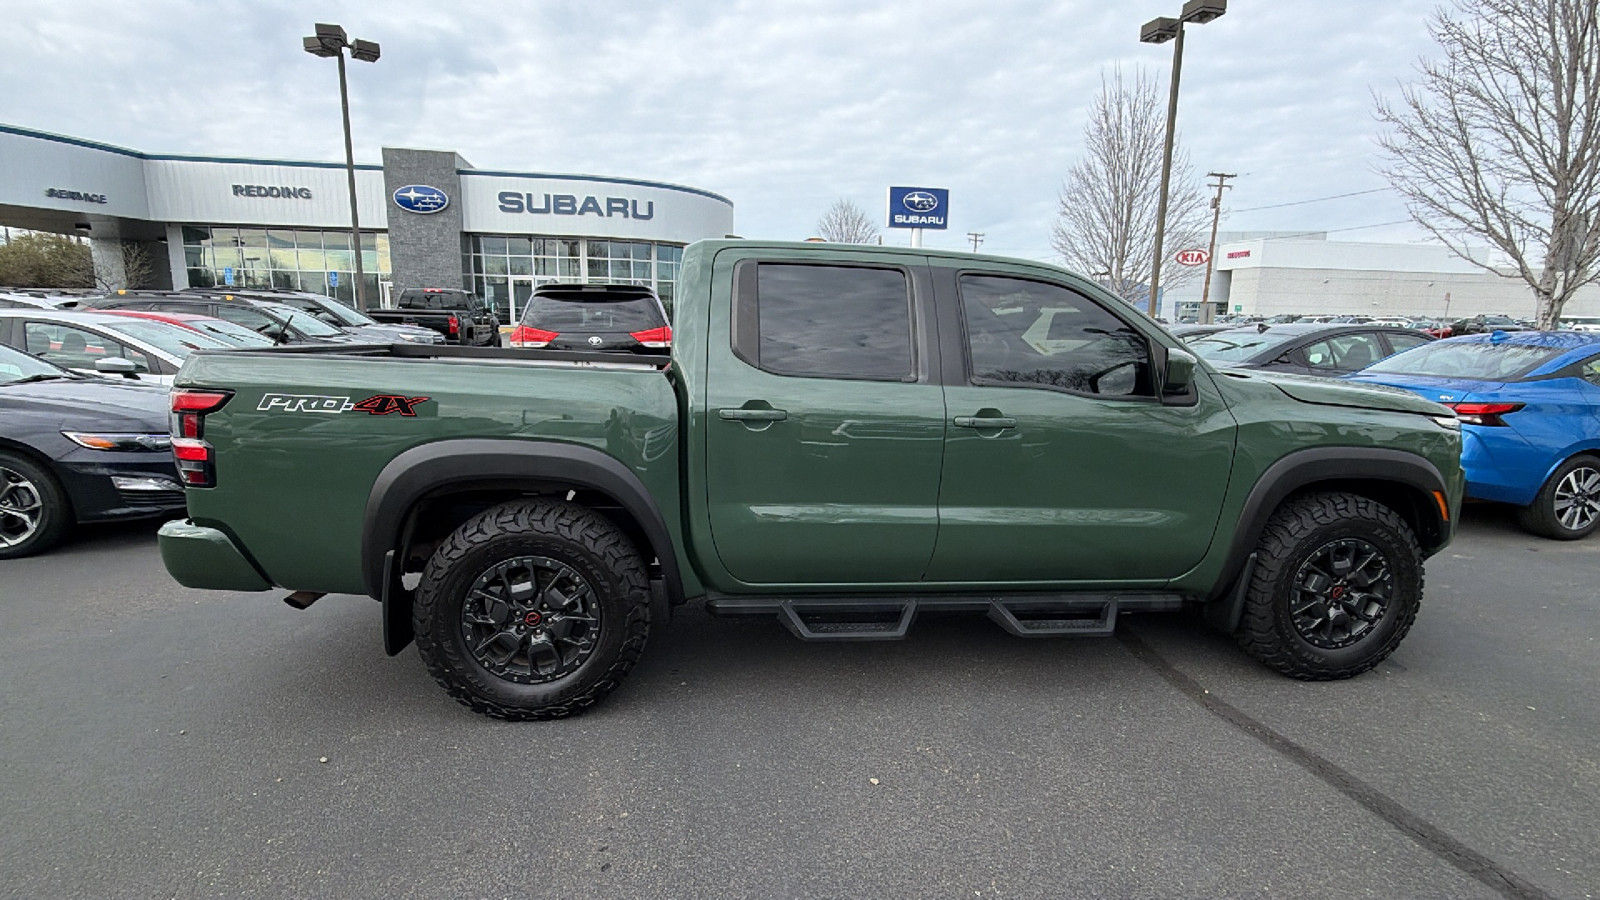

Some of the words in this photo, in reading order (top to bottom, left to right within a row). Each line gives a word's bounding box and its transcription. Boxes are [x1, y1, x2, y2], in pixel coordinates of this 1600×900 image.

[231, 184, 313, 199] REDDING
[498, 191, 654, 220] SUBARU
[894, 214, 944, 225] SUBARU
[1181, 252, 1204, 262] KIA
